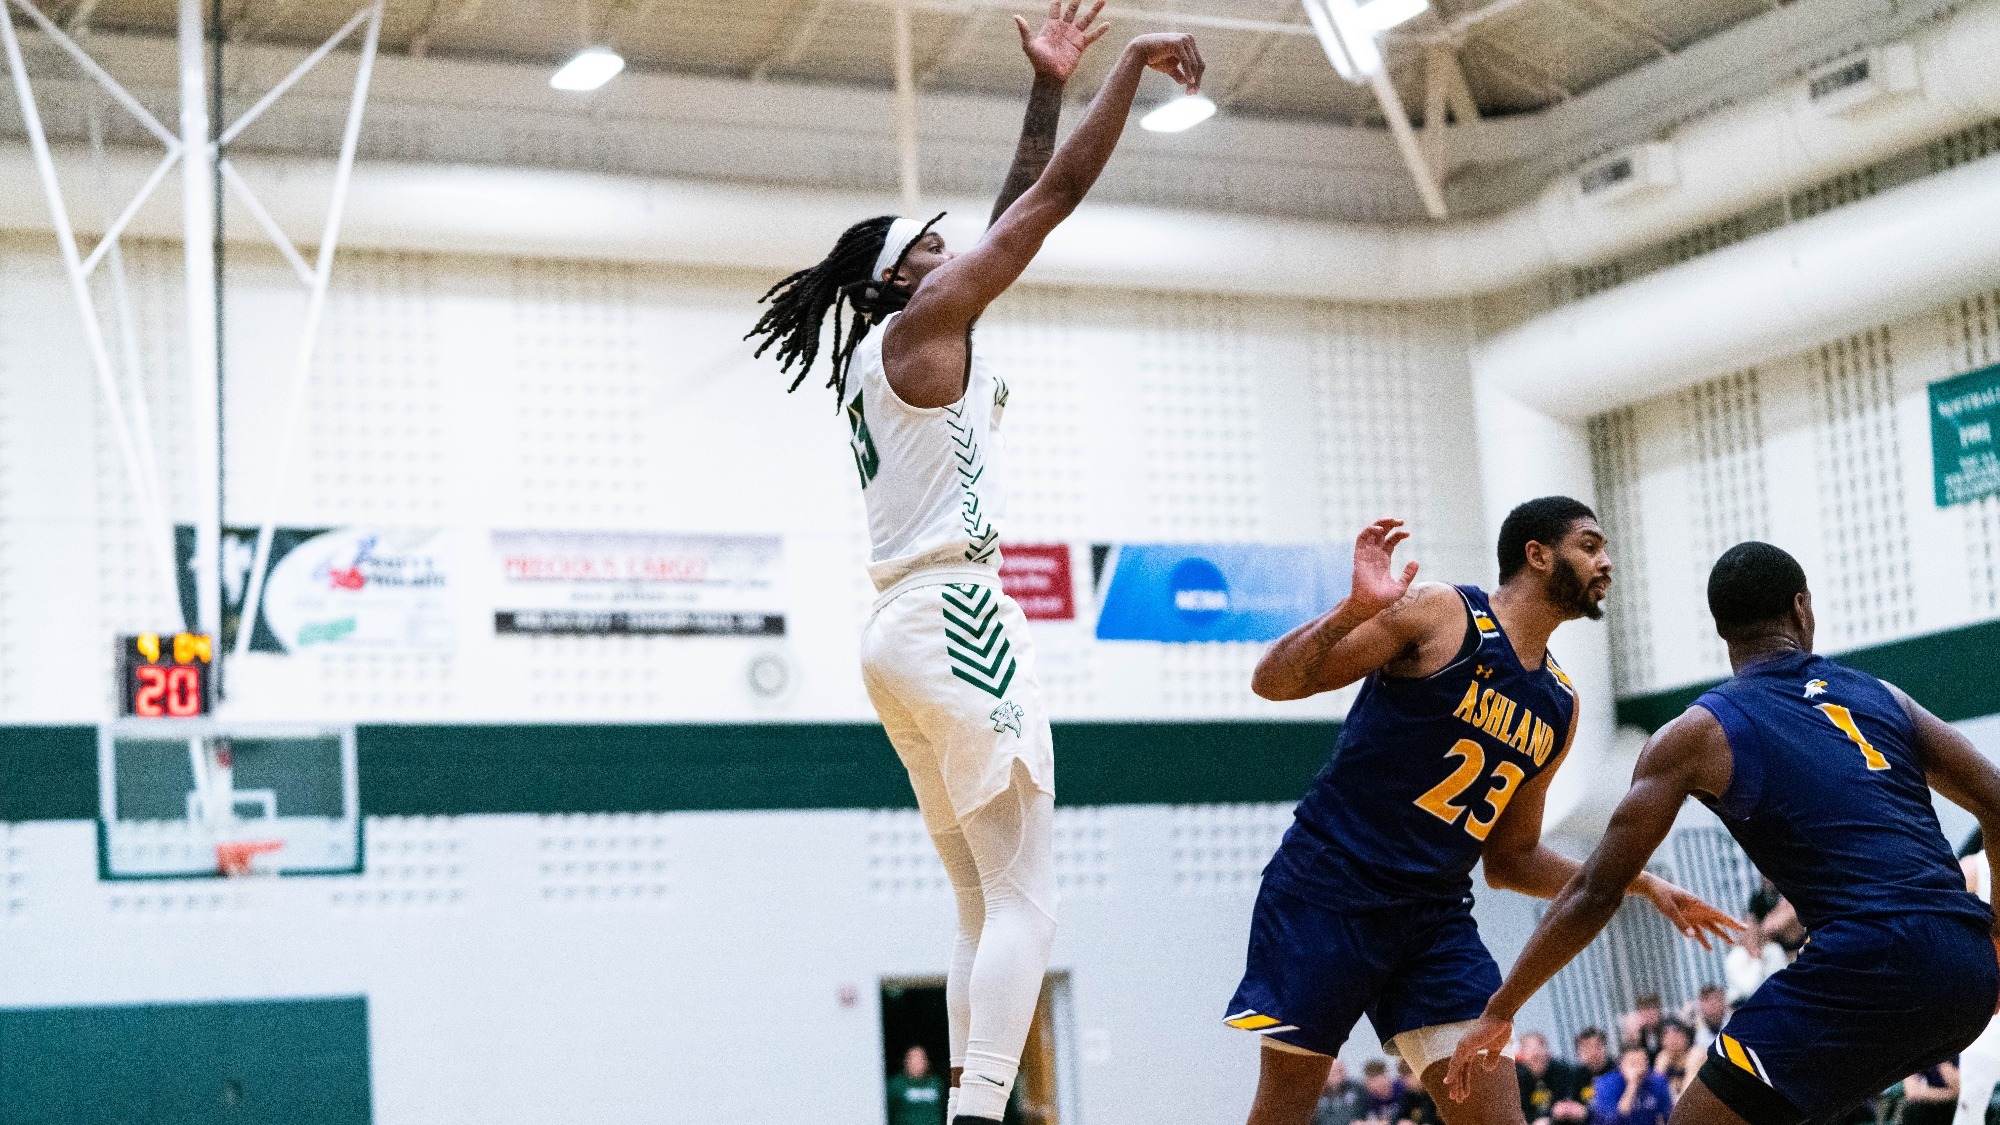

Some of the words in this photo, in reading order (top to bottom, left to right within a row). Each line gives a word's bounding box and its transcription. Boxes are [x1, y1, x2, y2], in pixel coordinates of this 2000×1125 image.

[136, 665, 200, 719] 20
[1453, 680, 1555, 767] ASHLAND
[1812, 702, 1891, 770] 1
[1413, 738, 1525, 842] 23
